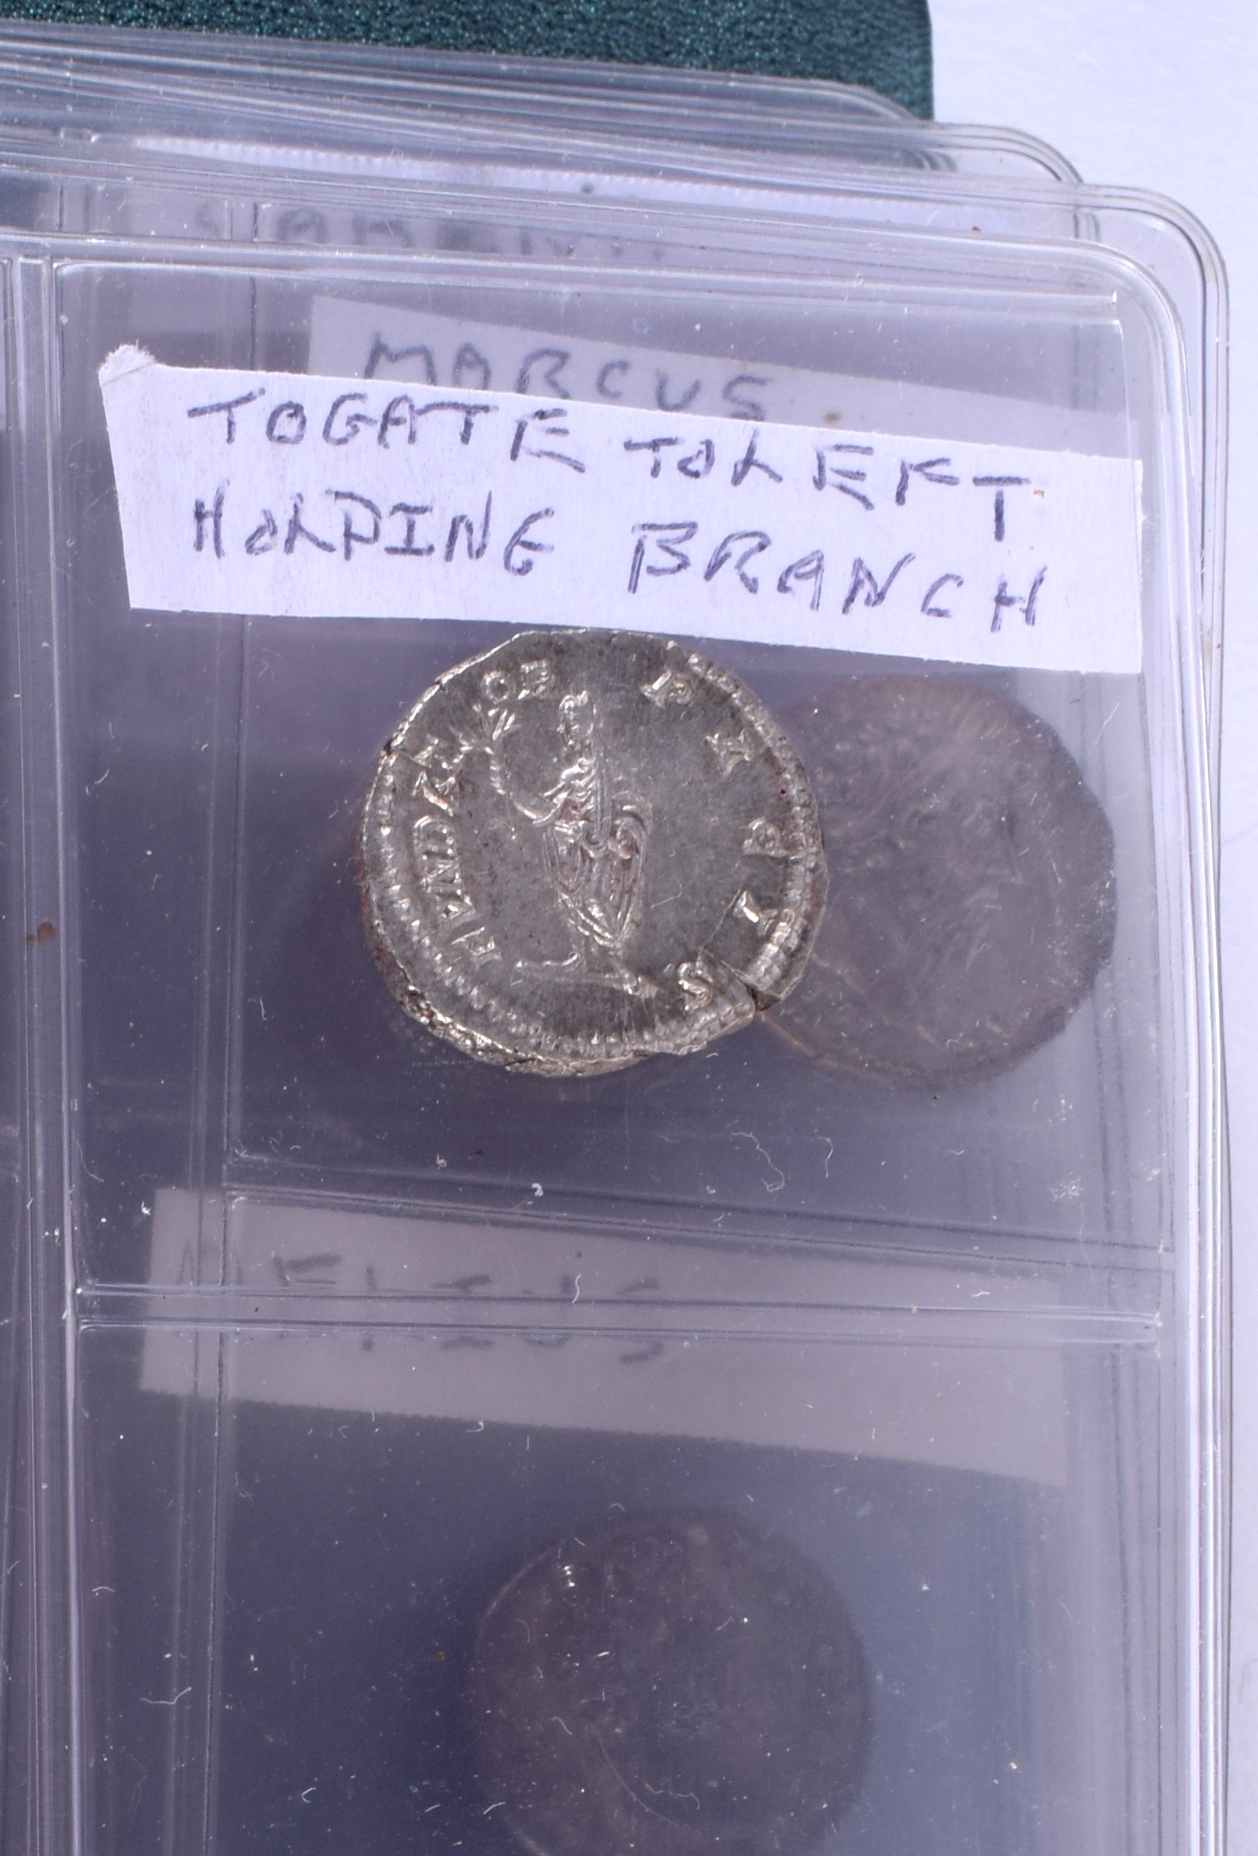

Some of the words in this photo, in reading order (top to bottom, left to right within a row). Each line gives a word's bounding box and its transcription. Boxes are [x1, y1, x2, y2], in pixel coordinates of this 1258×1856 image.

[364, 330, 777, 422] MARCUS
[187, 388, 586, 473] TOGATE
[192, 478, 556, 576] HOLDING
[628, 520, 1048, 634] BRANCH
